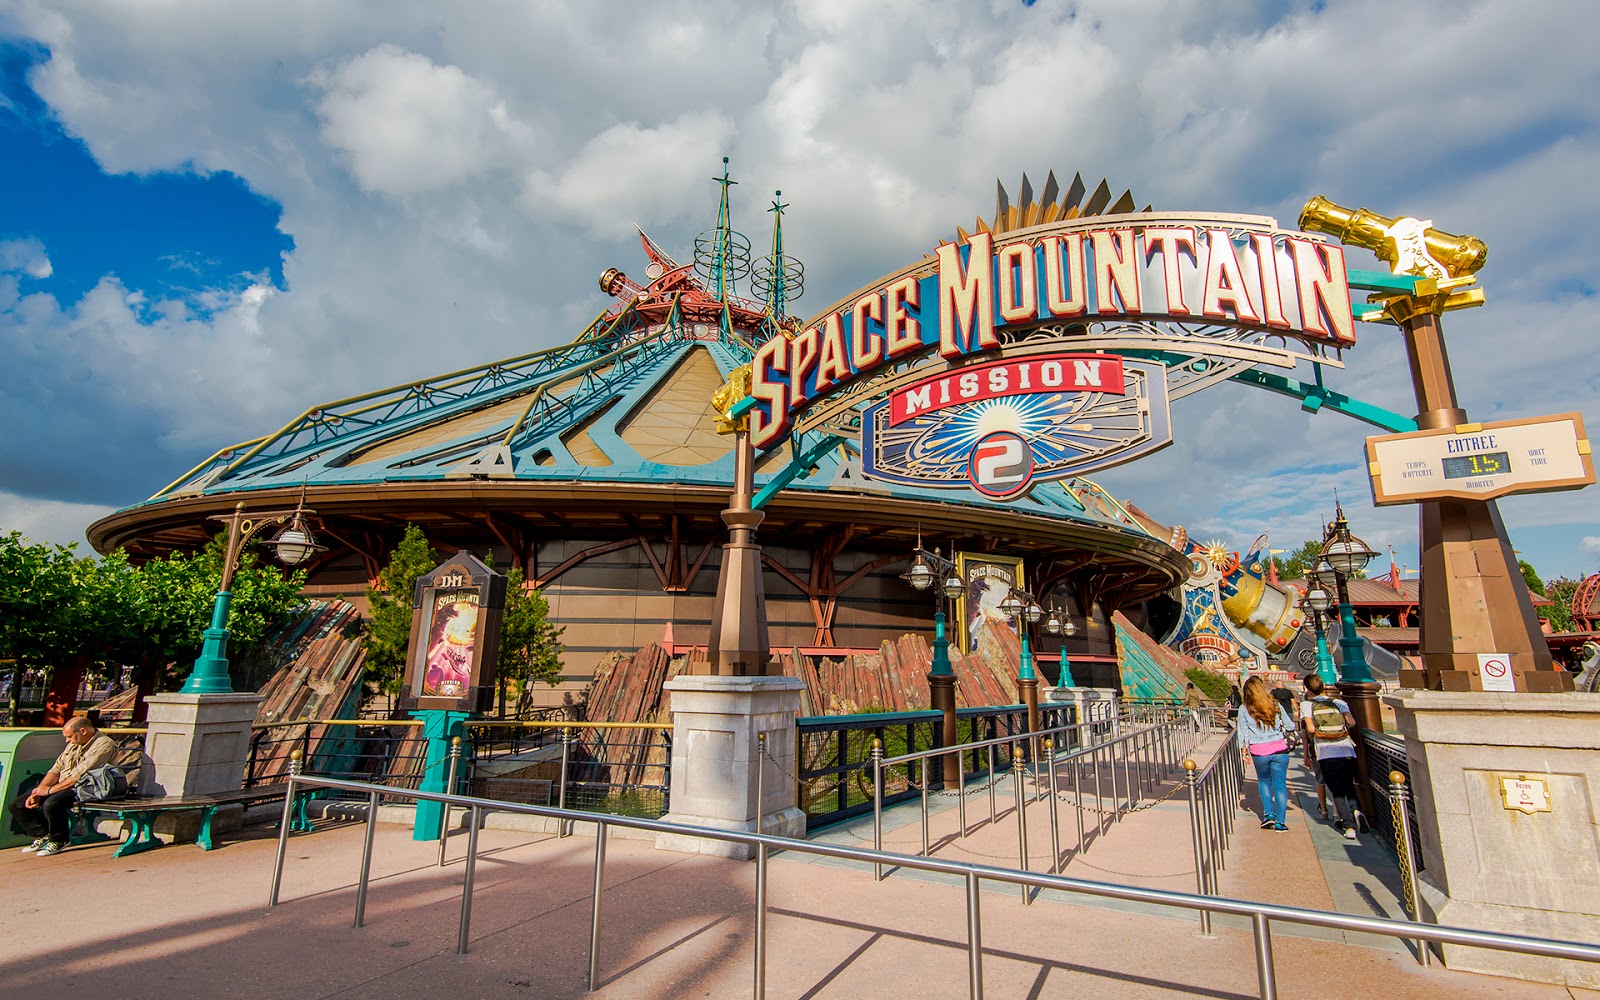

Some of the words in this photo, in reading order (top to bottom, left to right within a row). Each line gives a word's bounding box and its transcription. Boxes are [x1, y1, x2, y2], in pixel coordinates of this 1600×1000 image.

[750, 276, 925, 450] SPACE
[934, 228, 1357, 359] MOUNTAIN
[905, 360, 1102, 415] MISSION
[978, 439, 1023, 485] 2
[1405, 461, 1427, 469] TEMPS
[1468, 455, 1499, 473] 15
[1466, 480, 1494, 488] MINUTES
[970, 566, 986, 582] SPACE
[986, 565, 1011, 582] MOUNTAIN
[437, 594, 457, 611] SPACE
